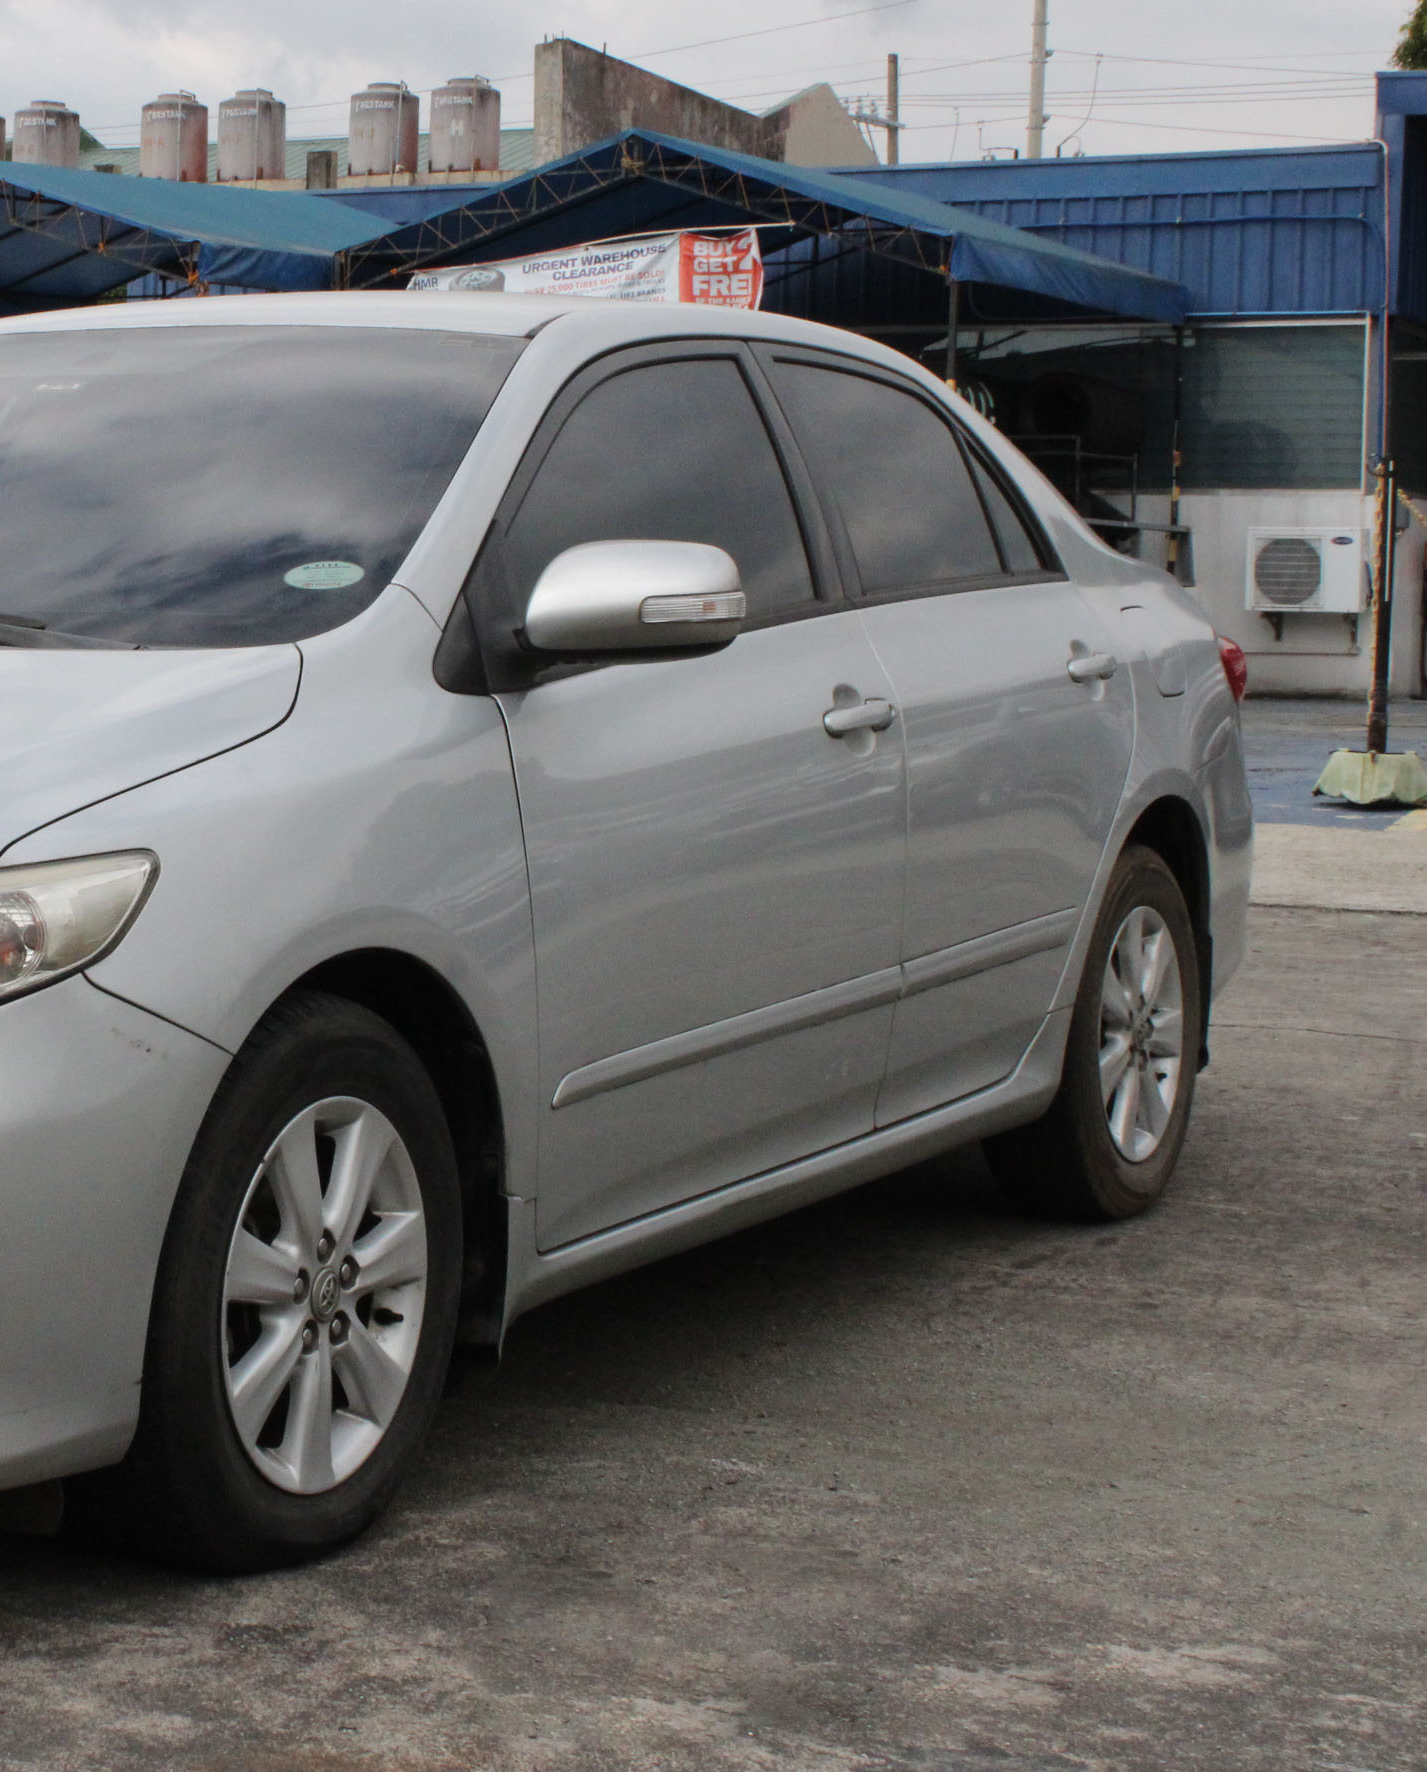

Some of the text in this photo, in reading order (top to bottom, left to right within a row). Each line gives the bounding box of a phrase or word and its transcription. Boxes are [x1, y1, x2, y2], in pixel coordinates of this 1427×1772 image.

[693, 240, 736, 256] BUY
[522, 245, 667, 274] URGENT WAREHOUSE
[693, 256, 738, 273] GET
[552, 261, 634, 281] CLEARANCE
[413, 277, 438, 290] HMR
